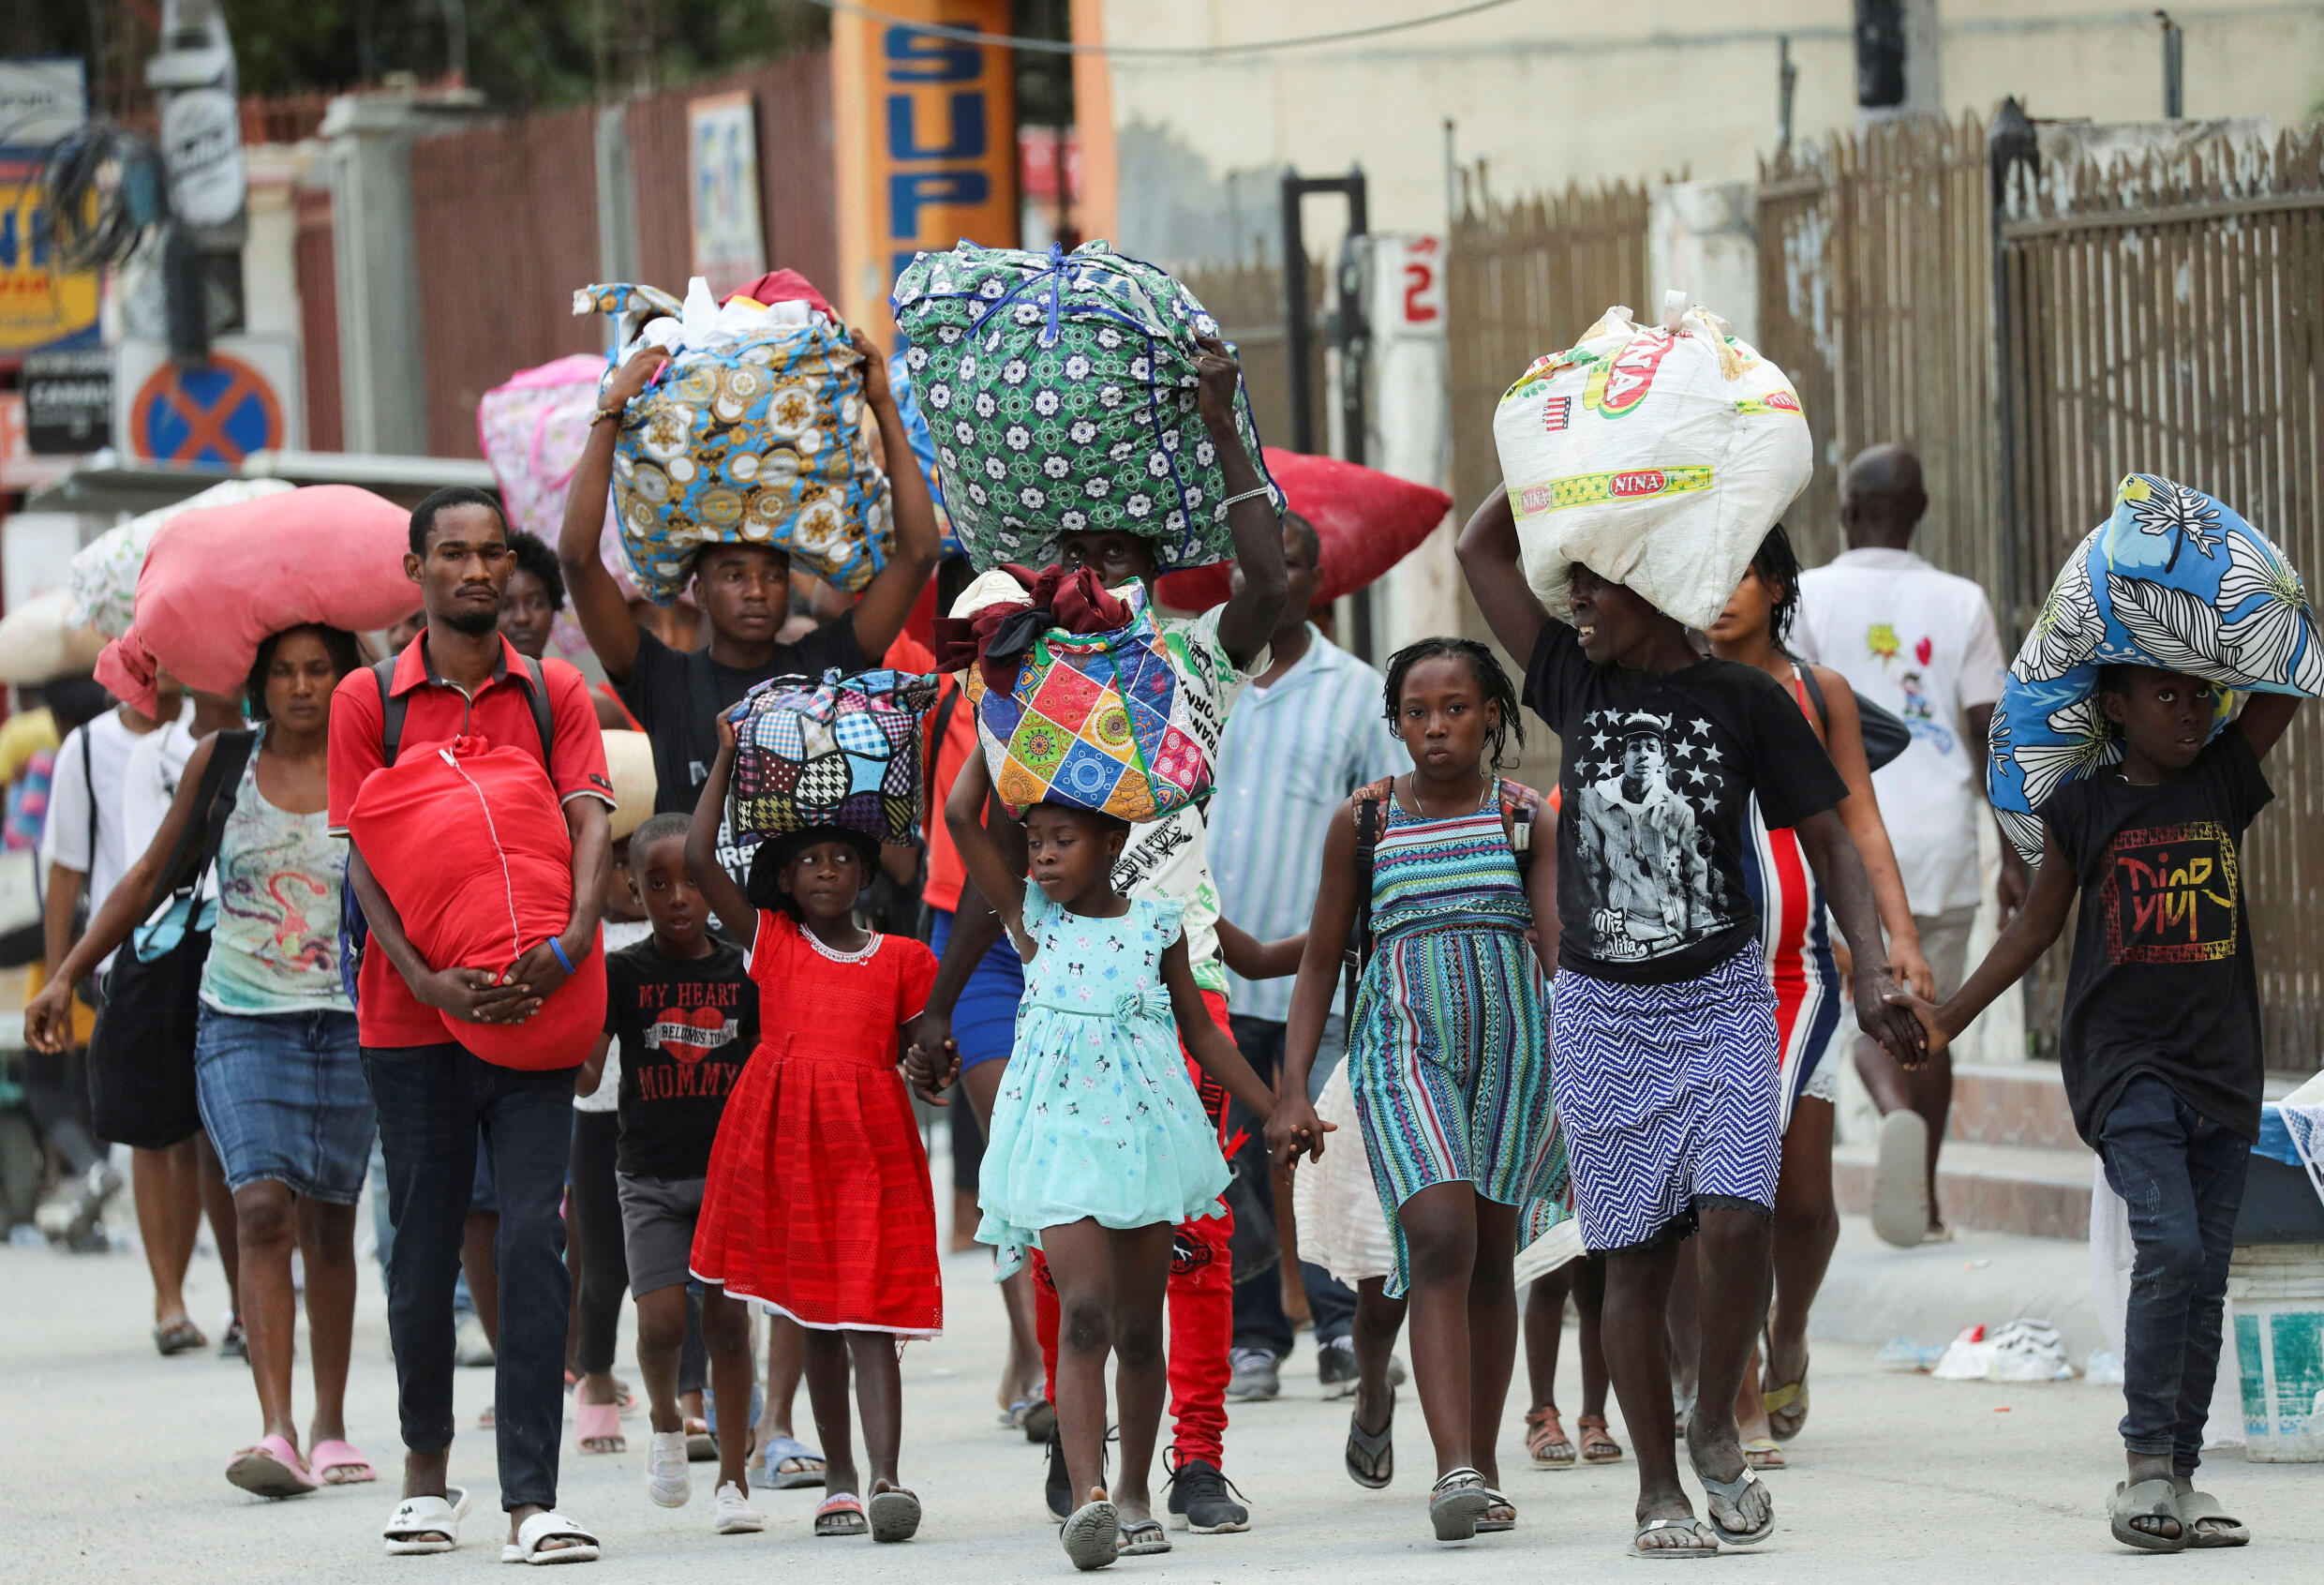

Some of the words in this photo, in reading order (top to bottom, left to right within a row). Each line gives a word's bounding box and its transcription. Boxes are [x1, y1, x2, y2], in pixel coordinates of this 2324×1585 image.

[1615, 473, 1660, 494] NINA
[1522, 489, 1549, 511] NINA
[1188, 714, 1217, 759] FRAN
[639, 984, 669, 1008] MY
[677, 982, 740, 1007] HEART
[661, 1024, 706, 1045] BELONGS
[709, 1032, 721, 1045] TO
[638, 1062, 739, 1101] MOMMY
